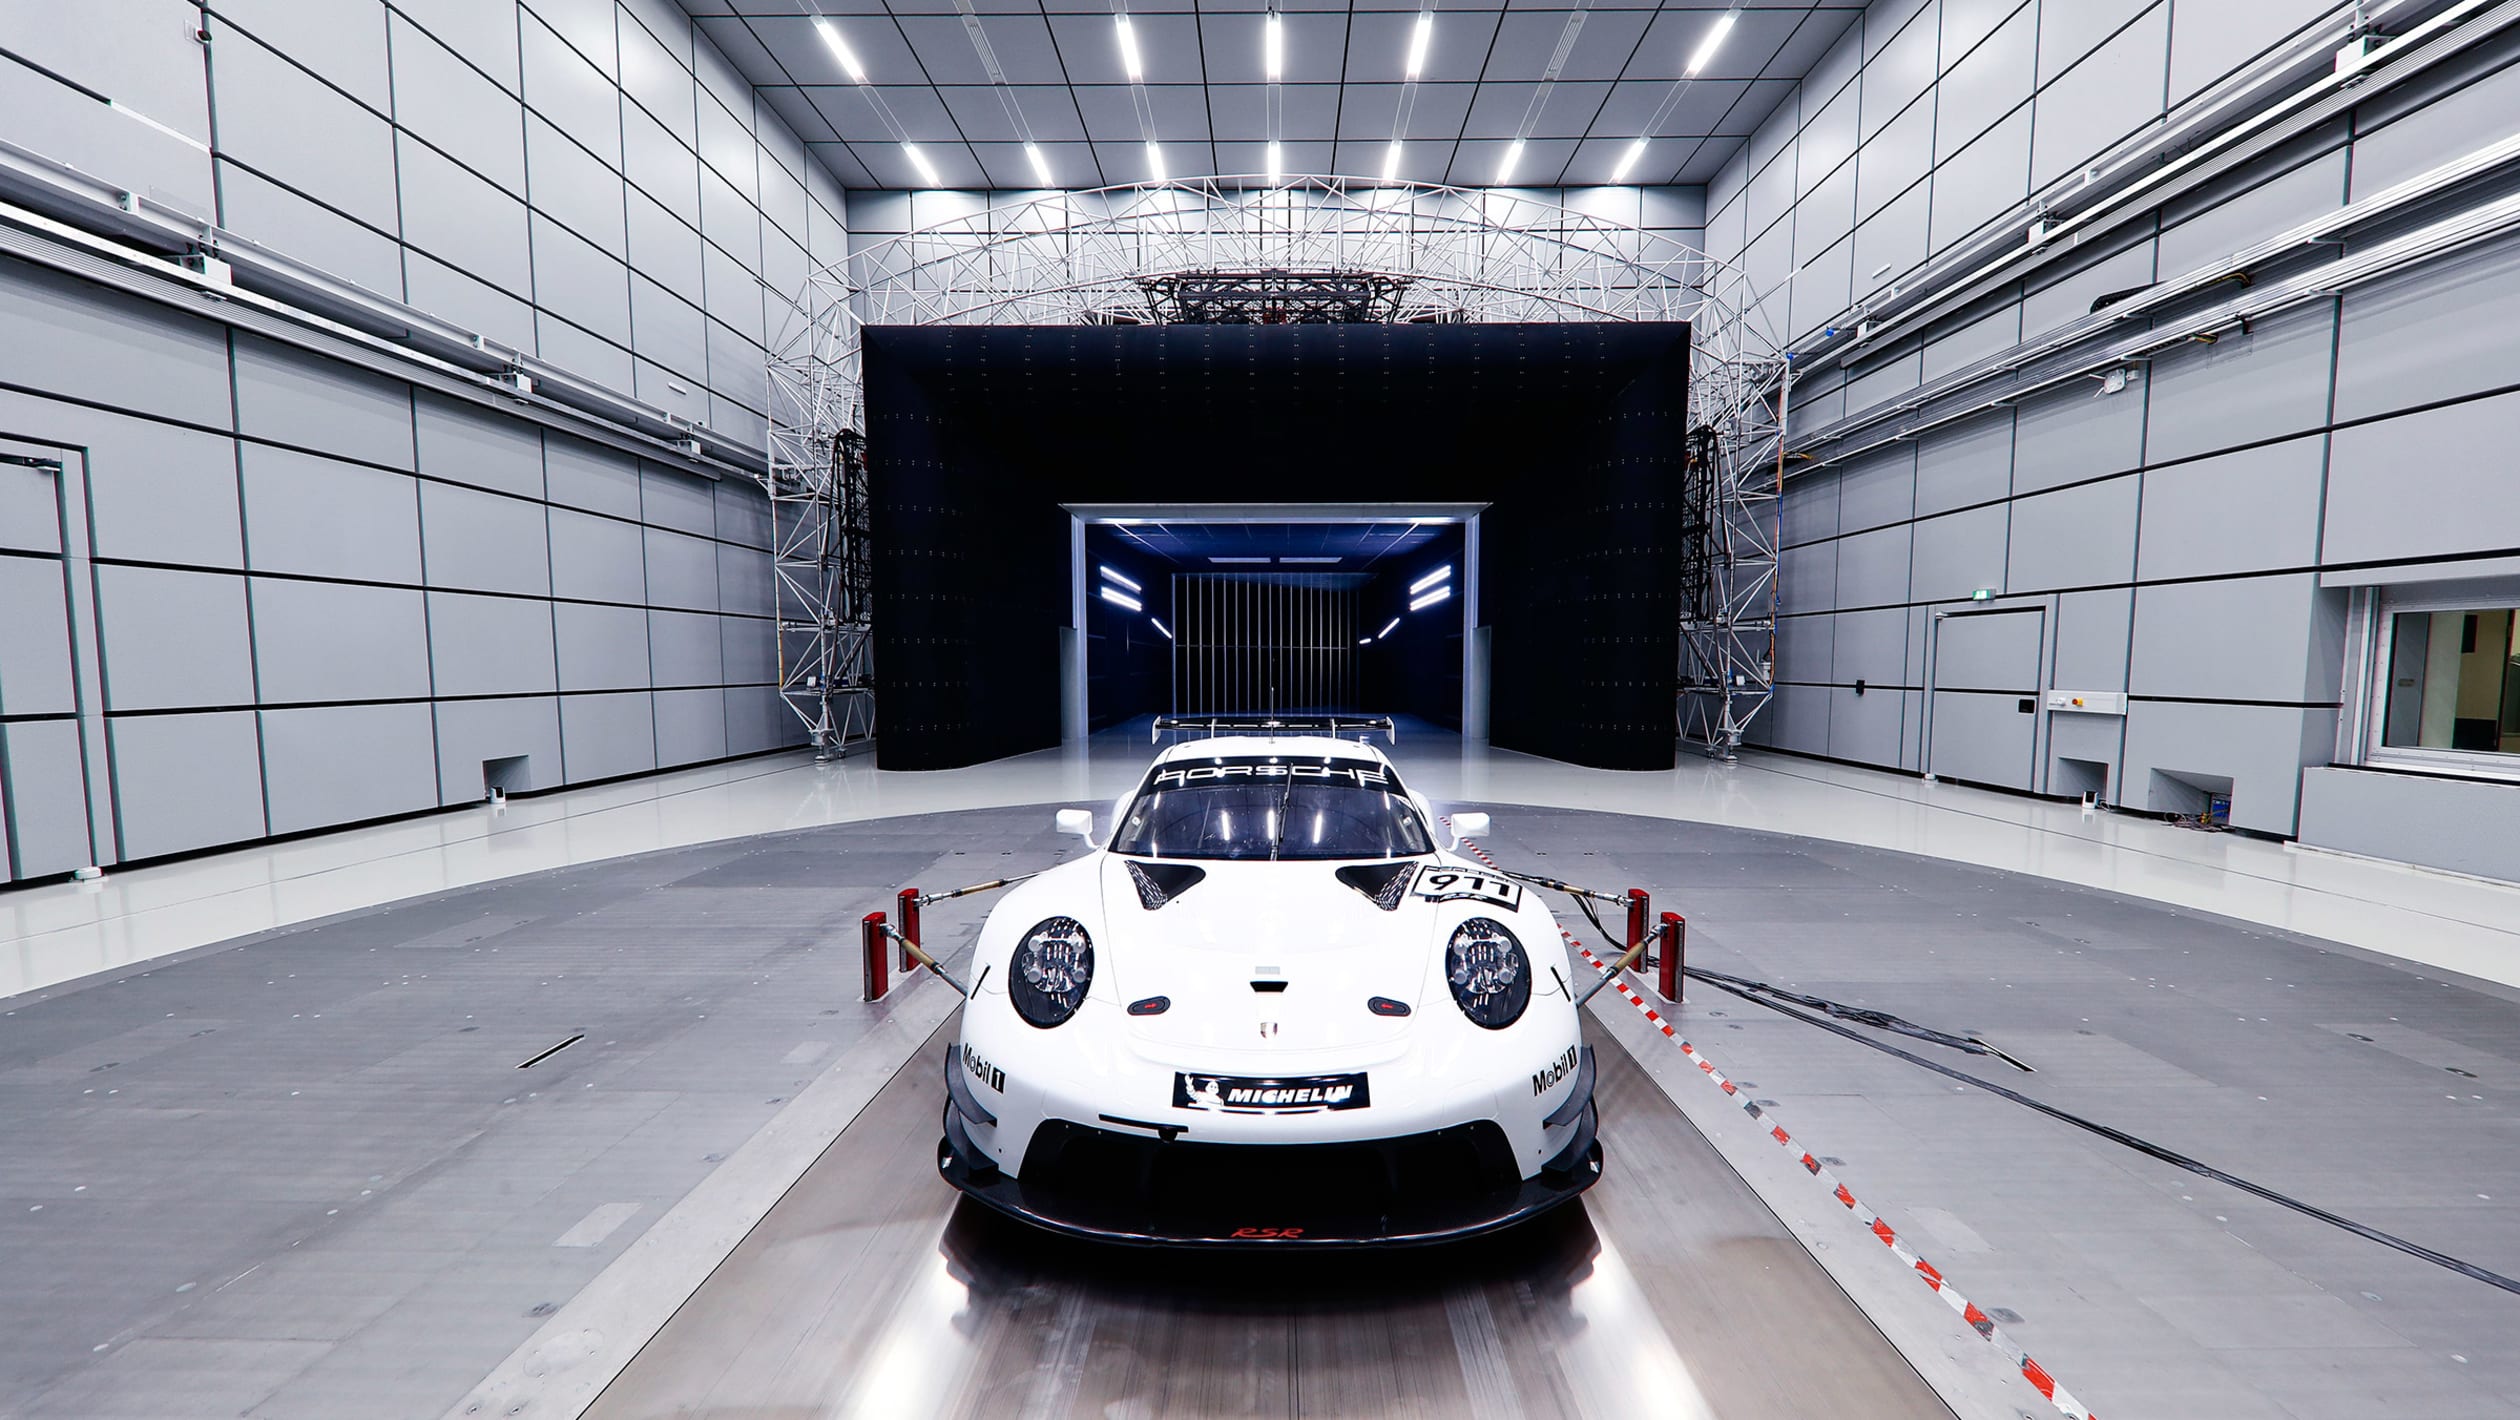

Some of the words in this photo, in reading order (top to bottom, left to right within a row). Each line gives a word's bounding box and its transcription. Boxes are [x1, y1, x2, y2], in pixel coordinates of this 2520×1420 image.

[1153, 765, 1389, 787] PORSCHE
[1429, 874, 1510, 897] 911
[963, 1042, 991, 1085] Mobil
[1532, 1053, 1569, 1097] Mobil
[1227, 1085, 1353, 1104] MICHELIN
[1230, 1227, 1304, 1239] RSR
